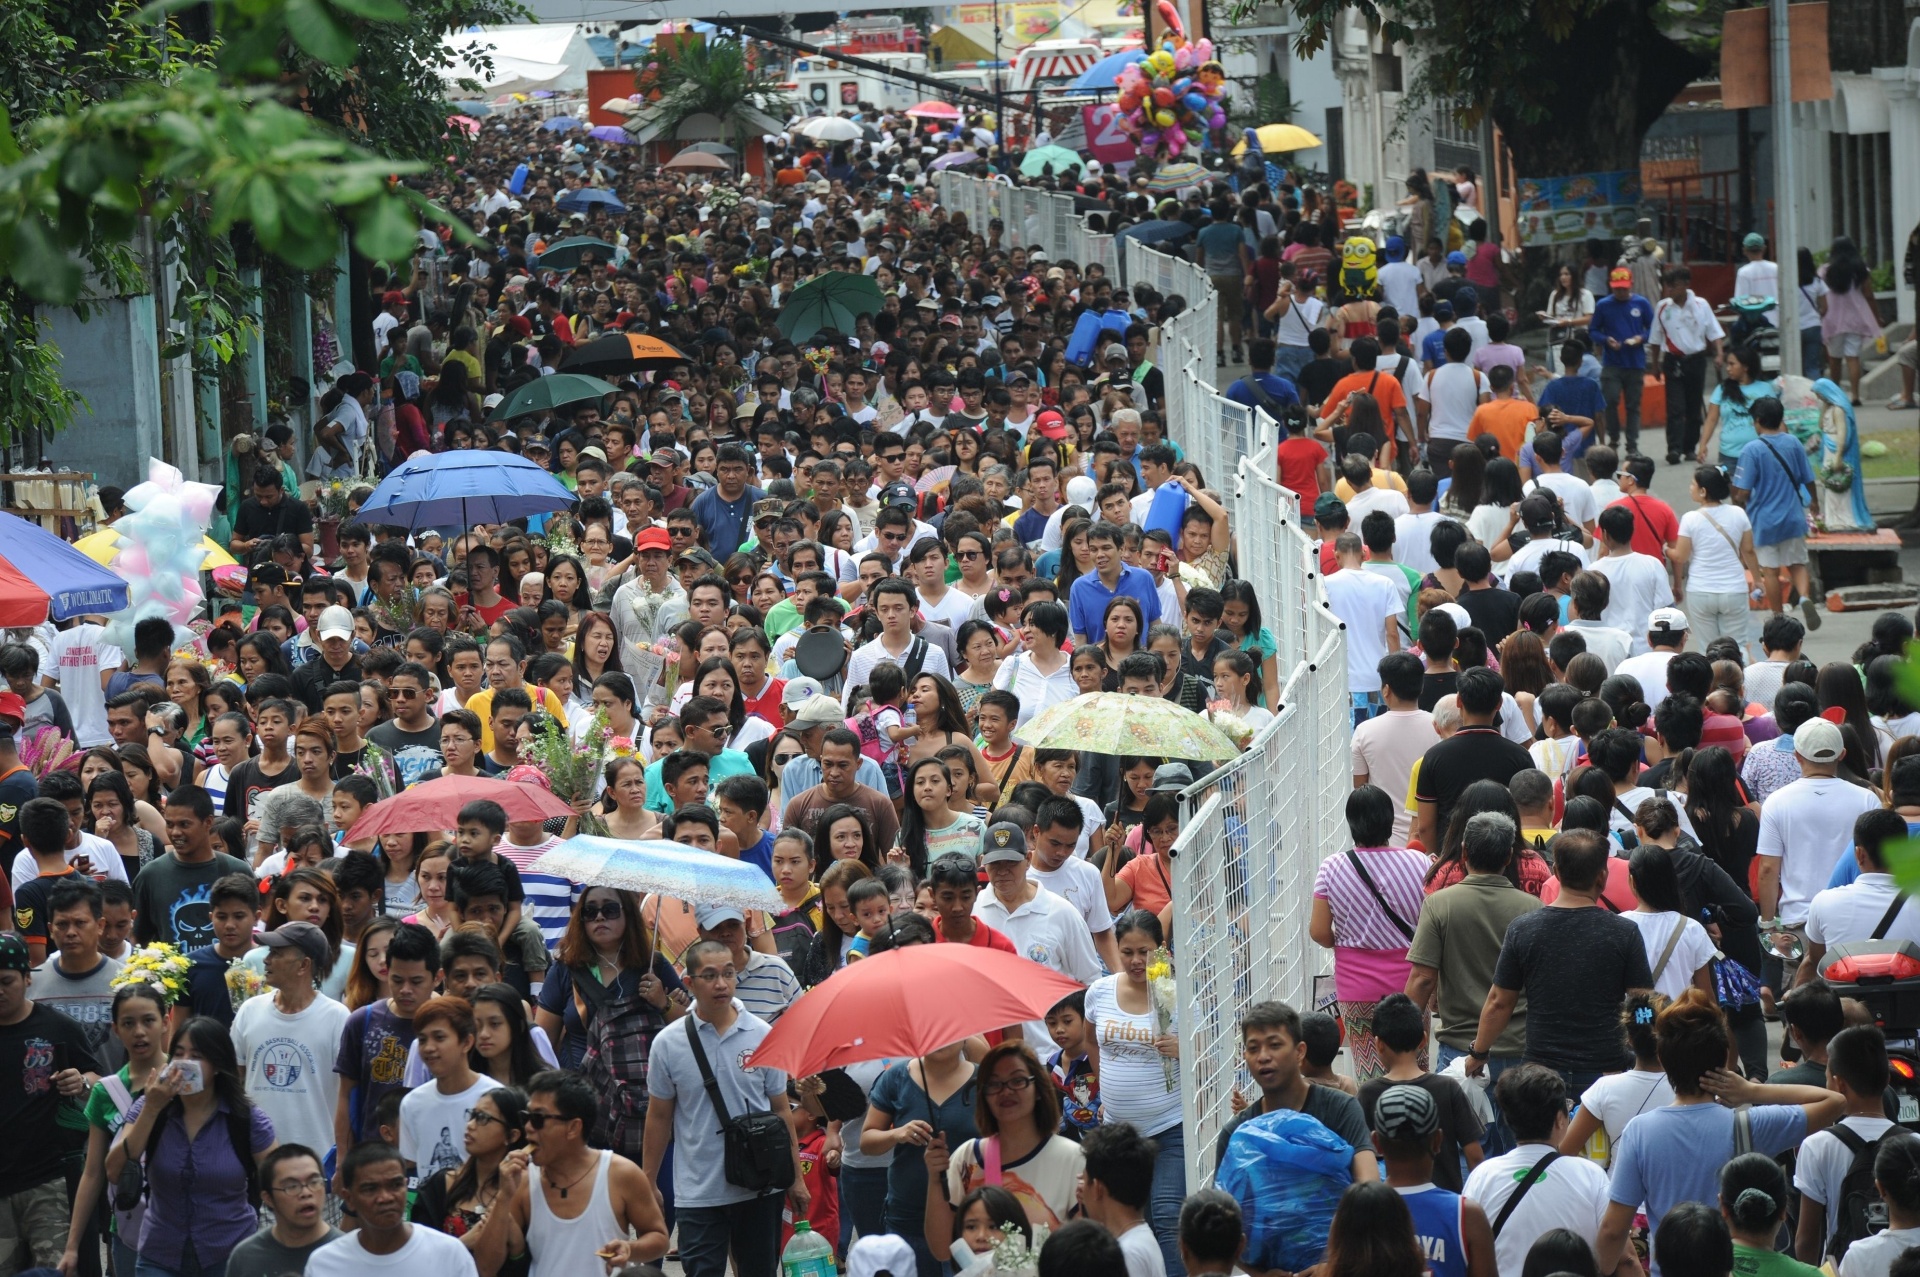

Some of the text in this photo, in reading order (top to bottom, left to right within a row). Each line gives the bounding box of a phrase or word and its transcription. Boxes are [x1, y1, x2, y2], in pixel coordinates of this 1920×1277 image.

[1092, 106, 1127, 146] 2
[1317, 996, 1330, 1007] THE
[265, 1037, 299, 1047] BASKETBALL
[266, 1063, 297, 1086] PBA
